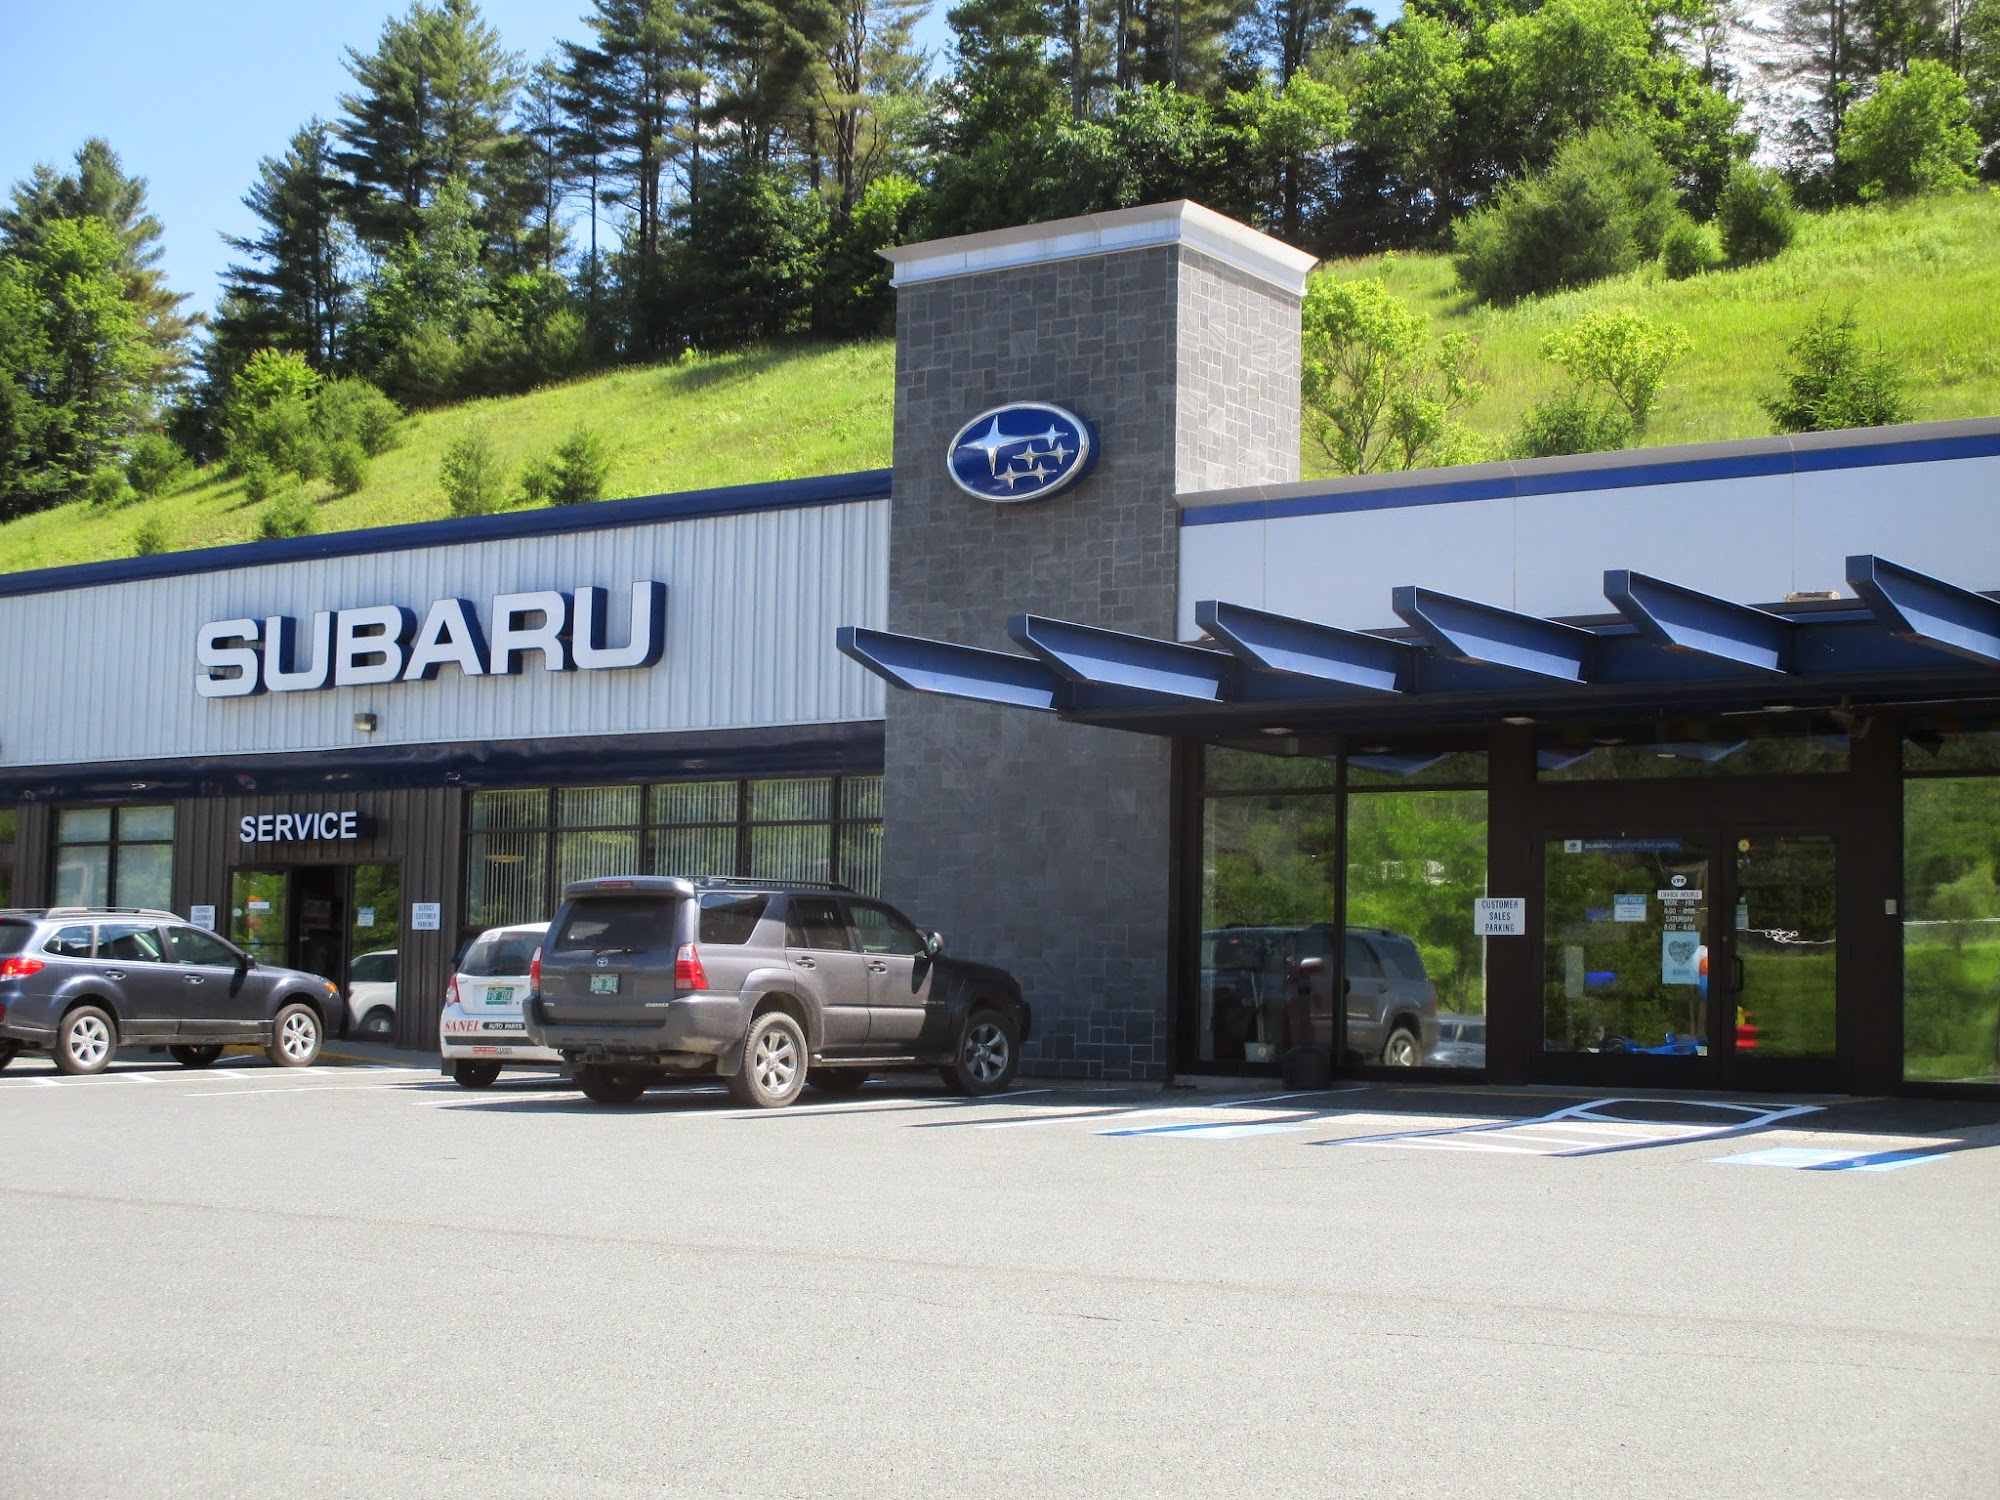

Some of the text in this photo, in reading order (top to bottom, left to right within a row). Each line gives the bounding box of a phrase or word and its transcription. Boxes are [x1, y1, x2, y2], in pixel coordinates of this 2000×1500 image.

[195, 580, 666, 698] SUBARU
[239, 811, 358, 843] SERVICE
[1481, 900, 1519, 909] CUSTOMER
[1489, 911, 1511, 921] SALES
[1665, 915, 1694, 923] SATURDAY
[1485, 923, 1515, 933] PARKING
[444, 1019, 480, 1032] SANEL
[488, 1022, 523, 1030] AUTO PARTS
